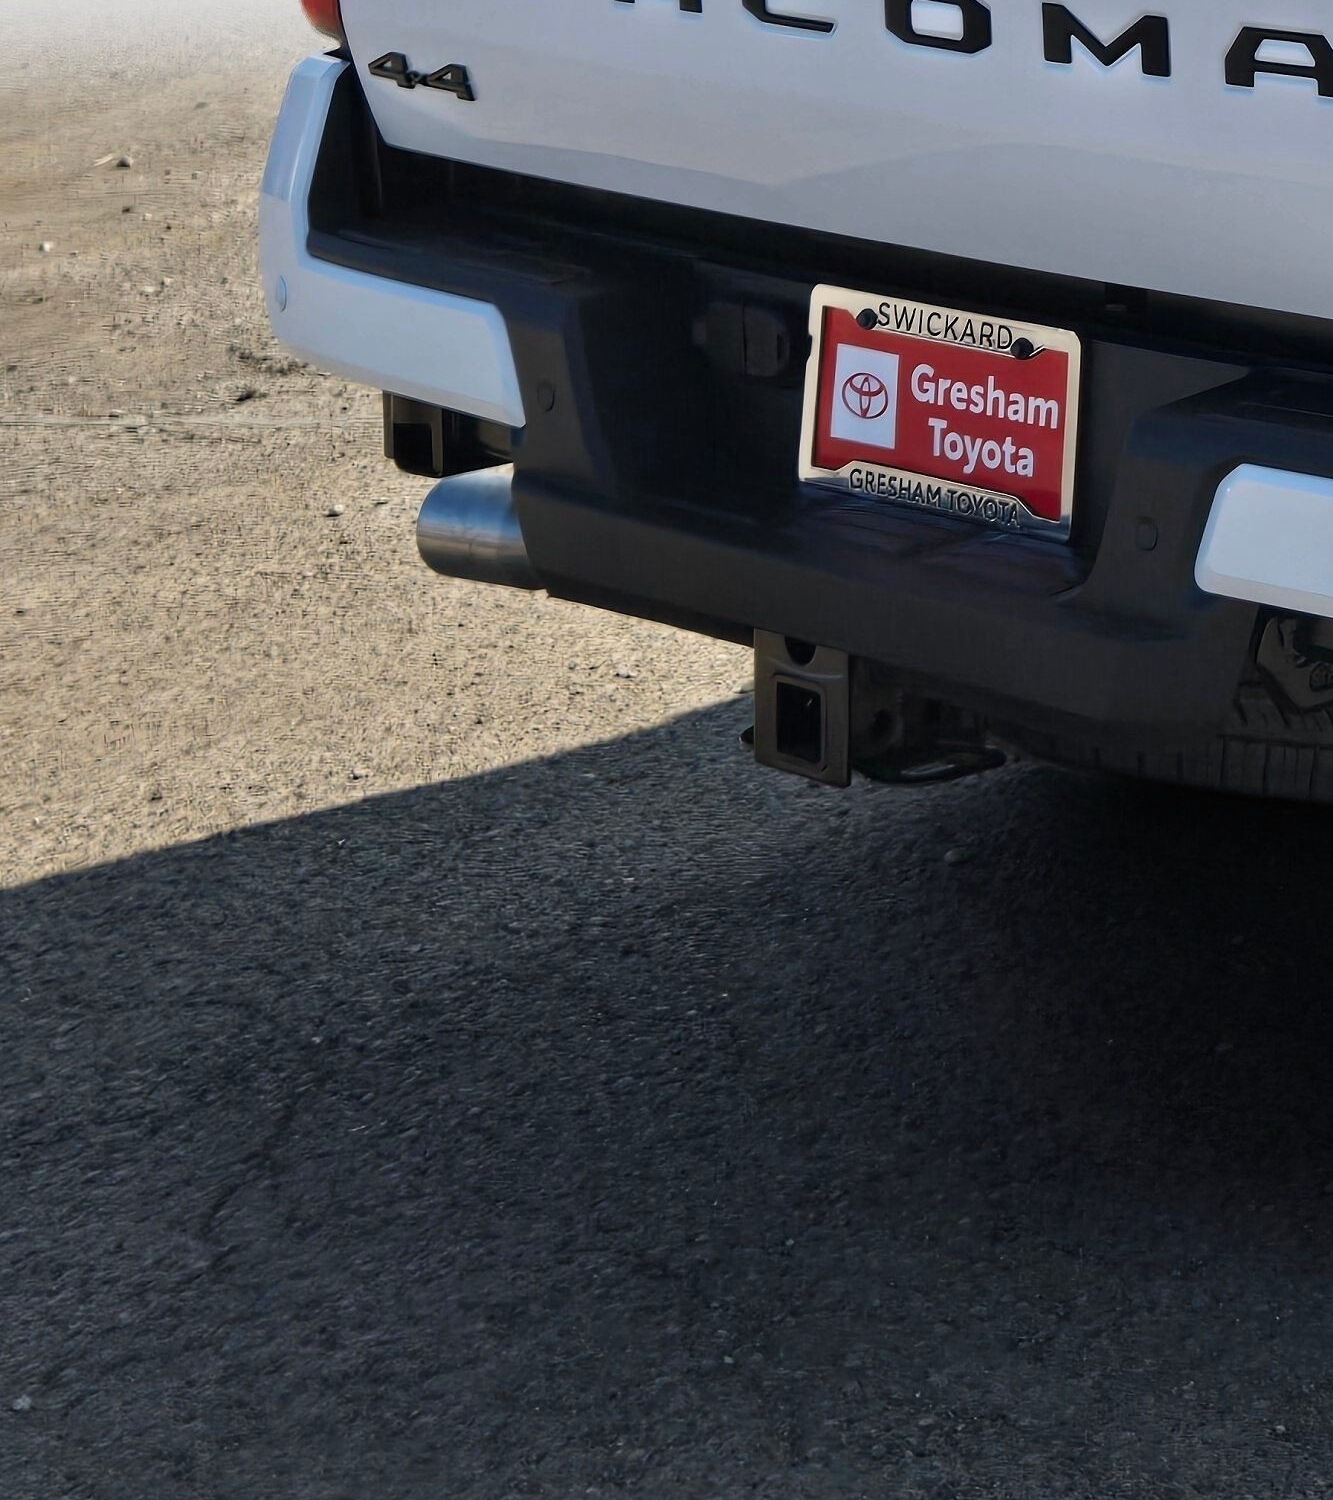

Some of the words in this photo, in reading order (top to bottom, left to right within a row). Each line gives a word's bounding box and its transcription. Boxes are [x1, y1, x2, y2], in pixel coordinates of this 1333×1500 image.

[876, 302, 1013, 350] SWICKARD
[910, 363, 1060, 430] Gresham
[927, 417, 1034, 477] Toyota
[849, 467, 942, 509] GRESHAM
[946, 489, 1021, 528] TOYOTA
